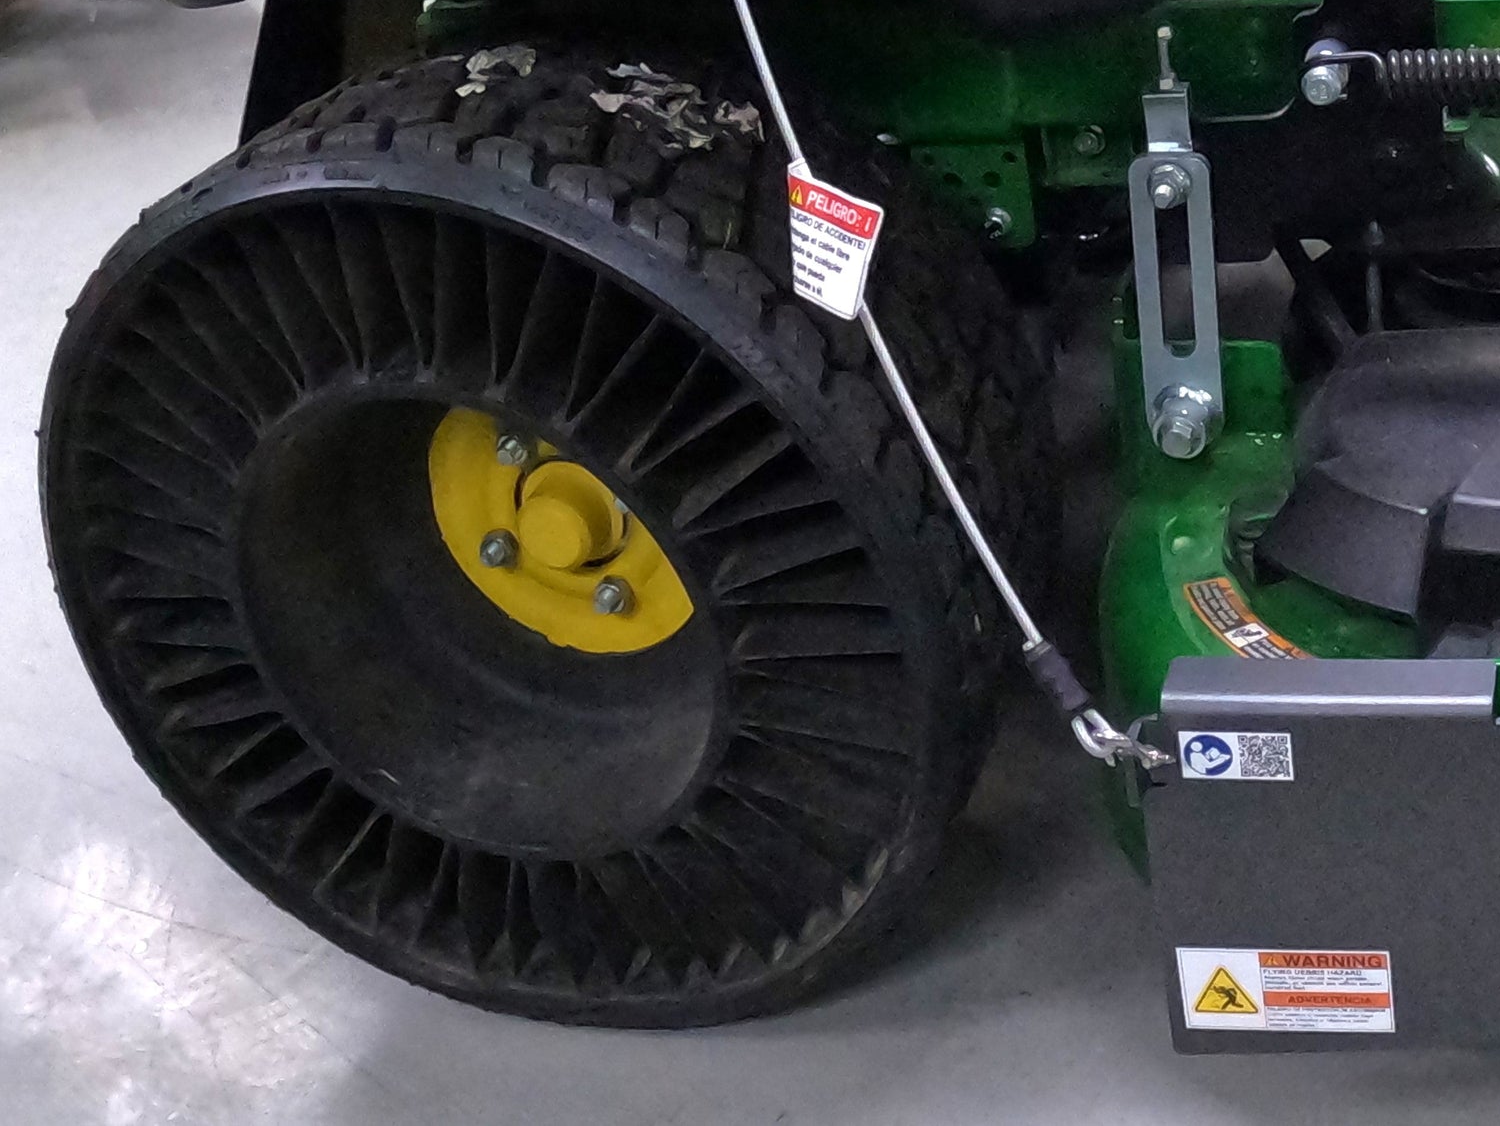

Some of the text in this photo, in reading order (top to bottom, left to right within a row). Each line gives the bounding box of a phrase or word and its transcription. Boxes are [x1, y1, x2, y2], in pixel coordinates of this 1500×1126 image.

[813, 220, 824, 232] DE
[1283, 955, 1382, 968] WARNING
[1288, 995, 1373, 1005] ADVERTENCIA
